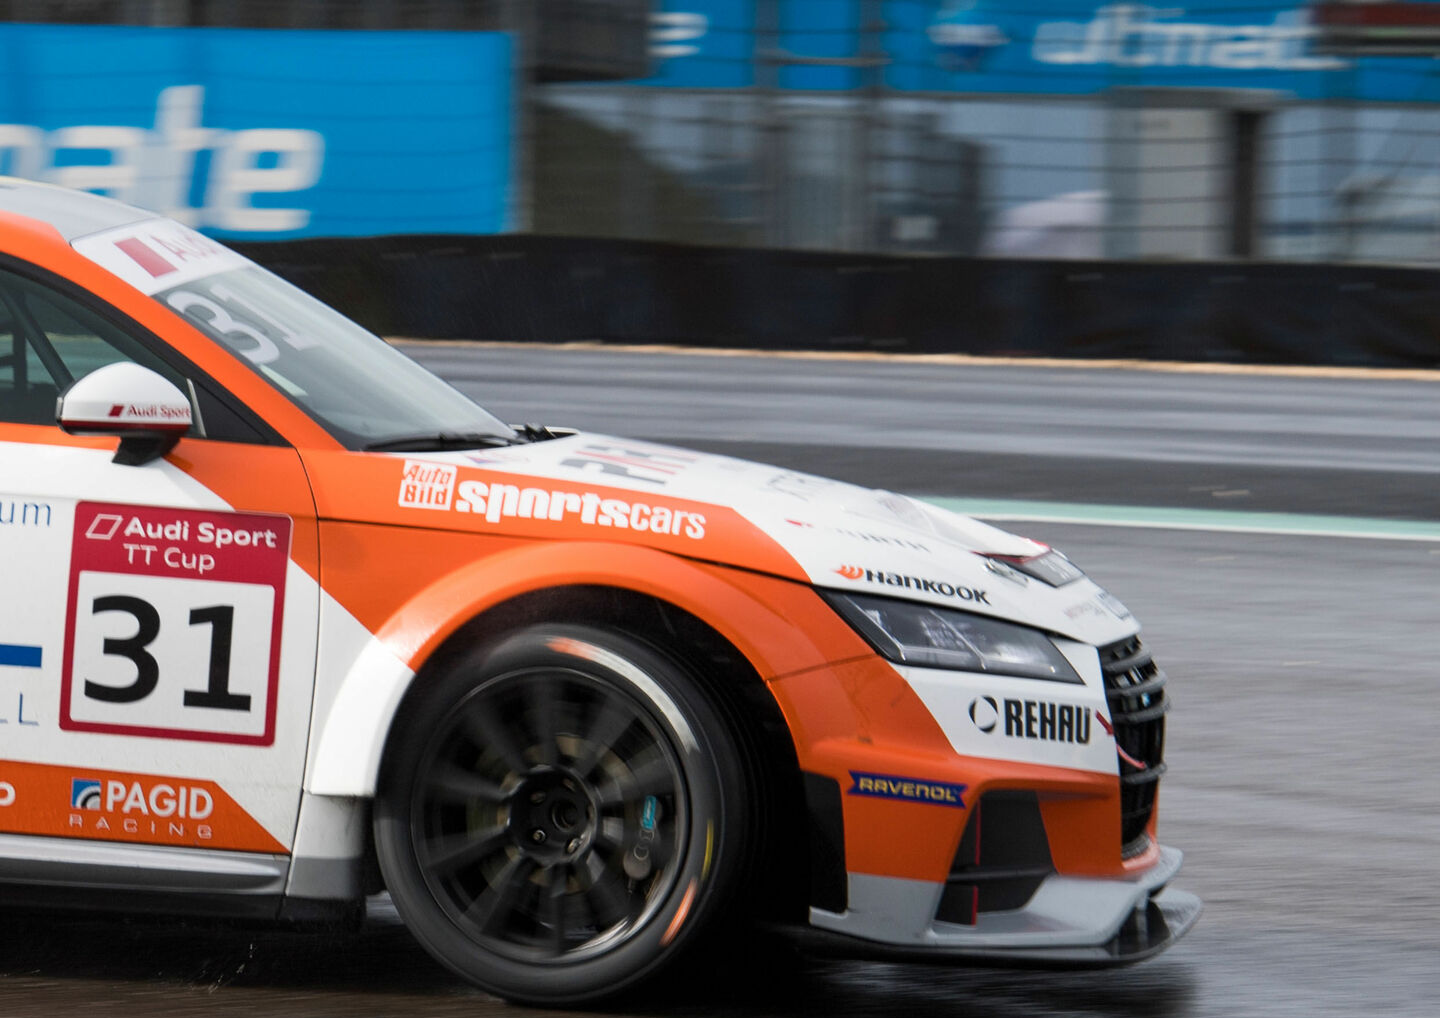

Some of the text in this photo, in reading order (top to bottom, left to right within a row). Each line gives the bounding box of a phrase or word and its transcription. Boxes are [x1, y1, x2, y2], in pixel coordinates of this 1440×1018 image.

[127, 404, 190, 418] Audi Sport
[403, 464, 452, 484] Auto
[456, 480, 707, 540] sportscars
[123, 517, 278, 550] Audi Sport
[122, 544, 216, 575] TT Cup
[83, 594, 253, 712] 31
[1004, 697, 1092, 745] REHAU
[106, 780, 214, 820] PAGID
[859, 777, 957, 803] RAVENOL
[69, 814, 213, 839] RACING
